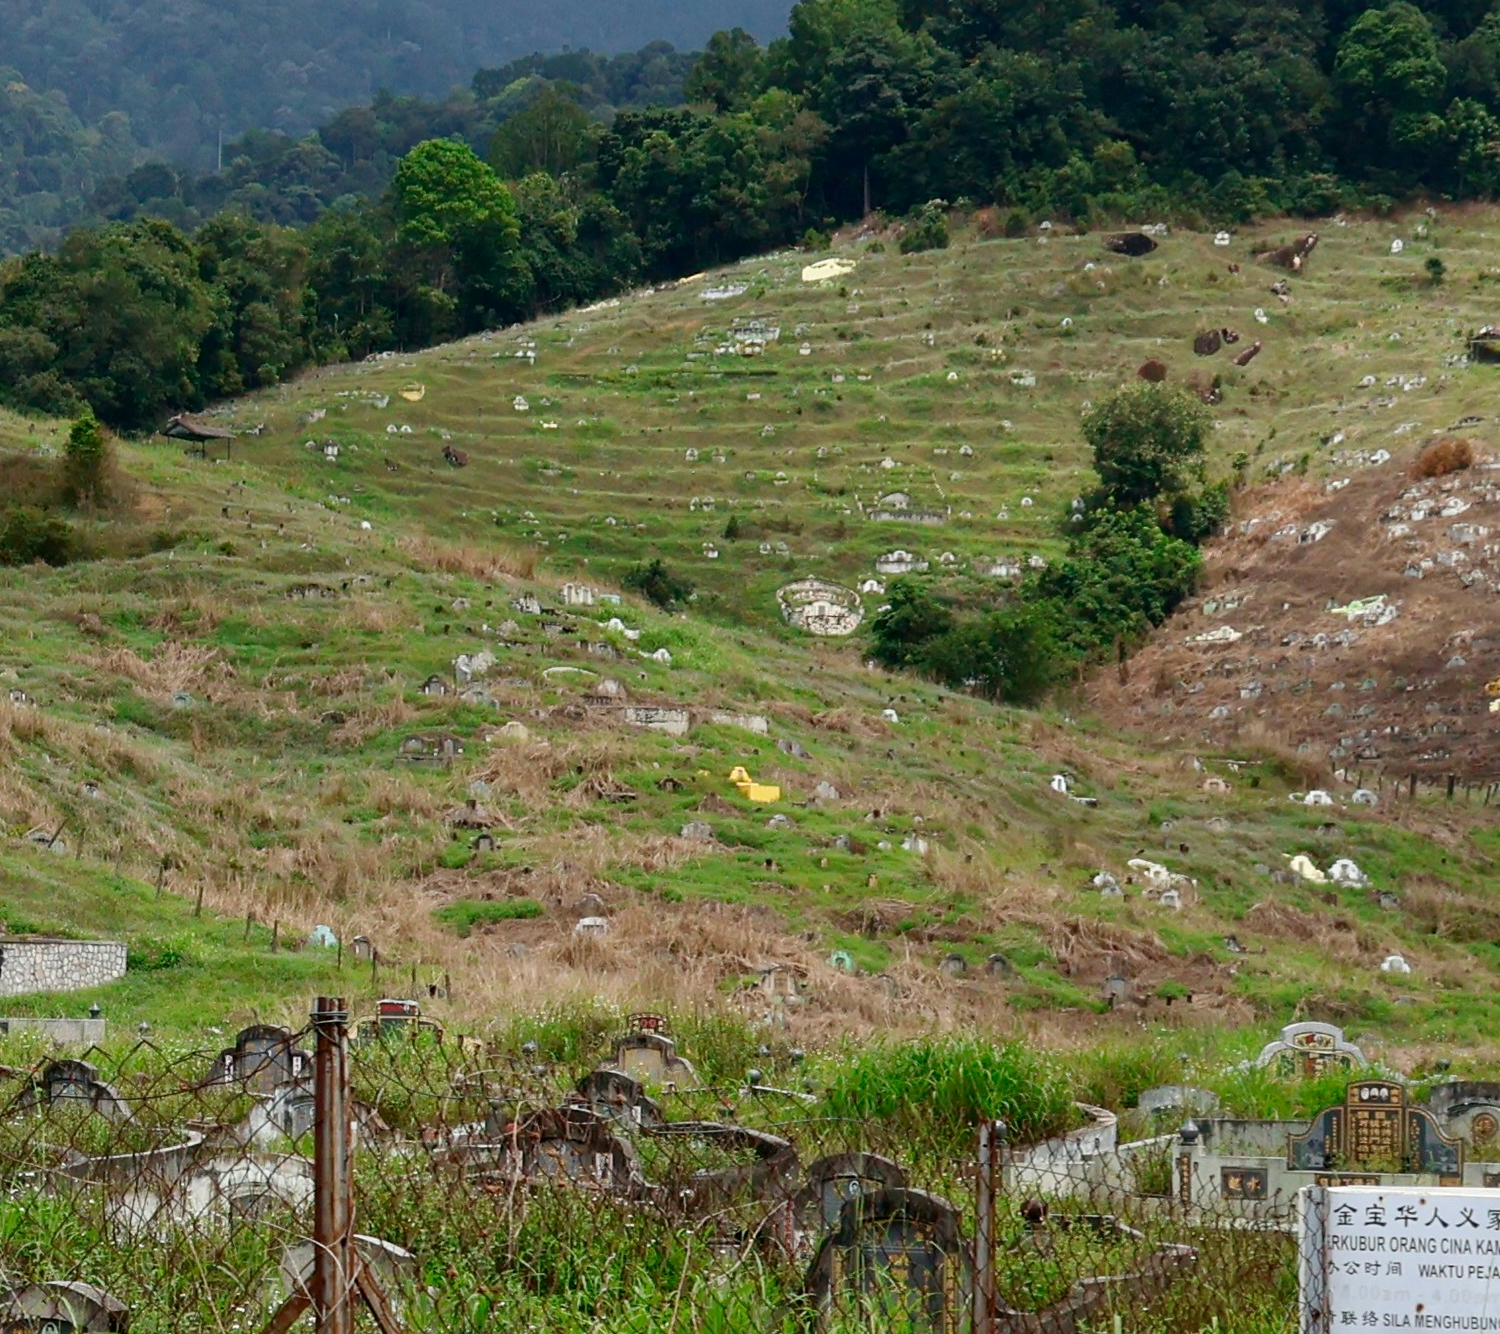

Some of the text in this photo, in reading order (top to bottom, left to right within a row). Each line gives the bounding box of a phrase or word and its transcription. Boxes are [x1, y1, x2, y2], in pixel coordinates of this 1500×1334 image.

[1327, 1234, 1386, 1253] ERKUBUR
[1389, 1236, 1437, 1254] ORANG
[1440, 1238, 1472, 1255] CINA
[1418, 1264, 1464, 1279] WAKTU
[1383, 1313, 1411, 1328] SILA
